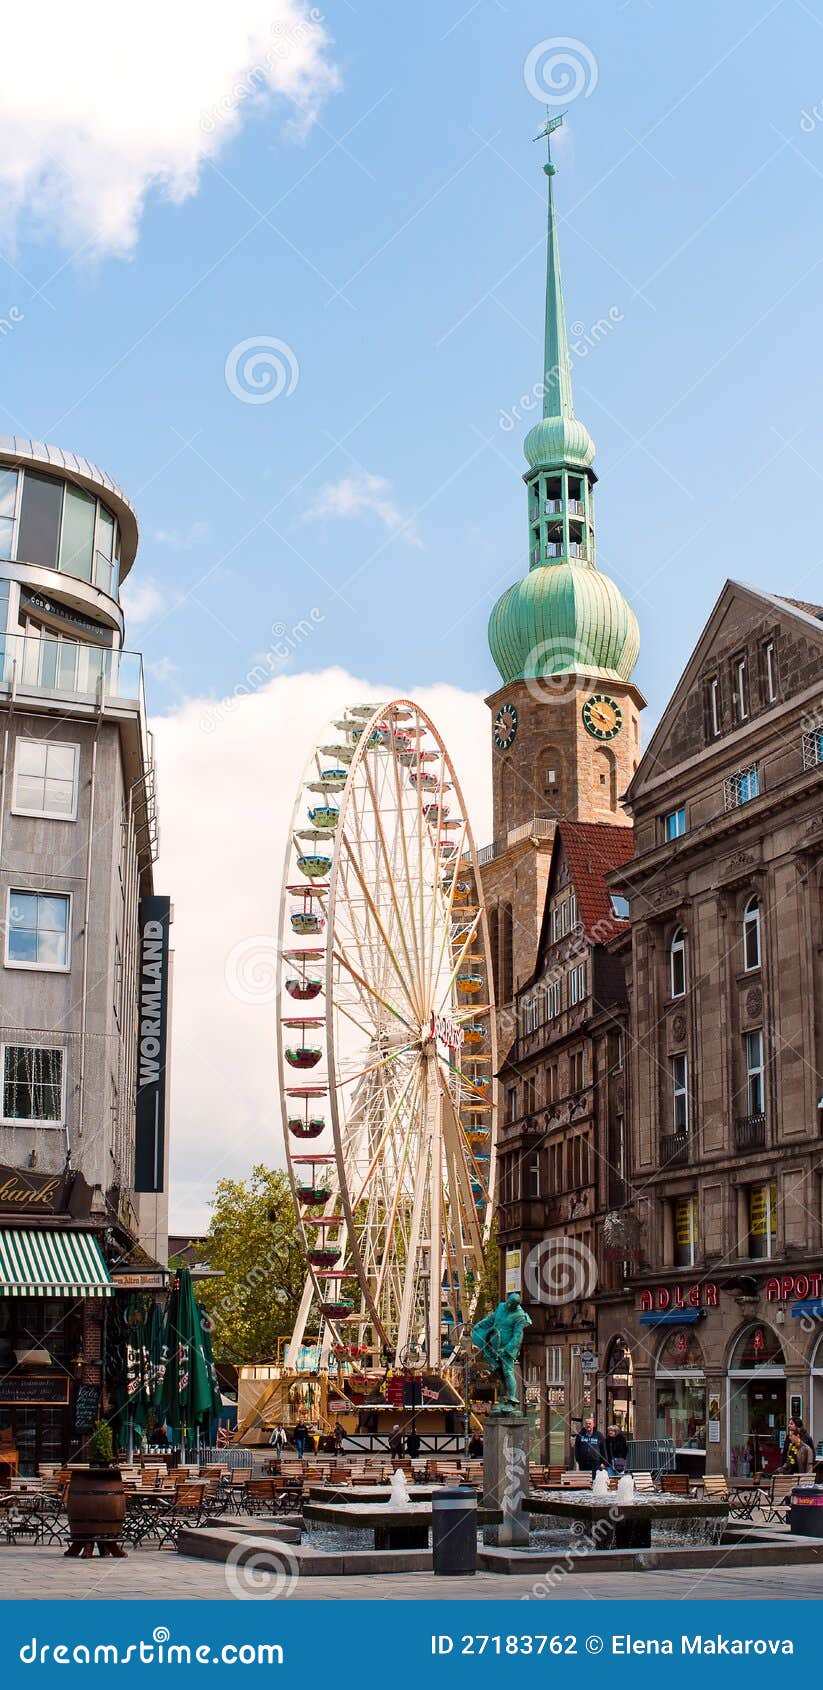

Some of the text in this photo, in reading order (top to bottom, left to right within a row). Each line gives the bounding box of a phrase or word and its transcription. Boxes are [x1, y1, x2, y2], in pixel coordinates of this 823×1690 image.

[140, 920, 164, 1087] WORMLAND
[640, 1282, 721, 1311] ADLER
[766, 1272, 822, 1301] APOT
